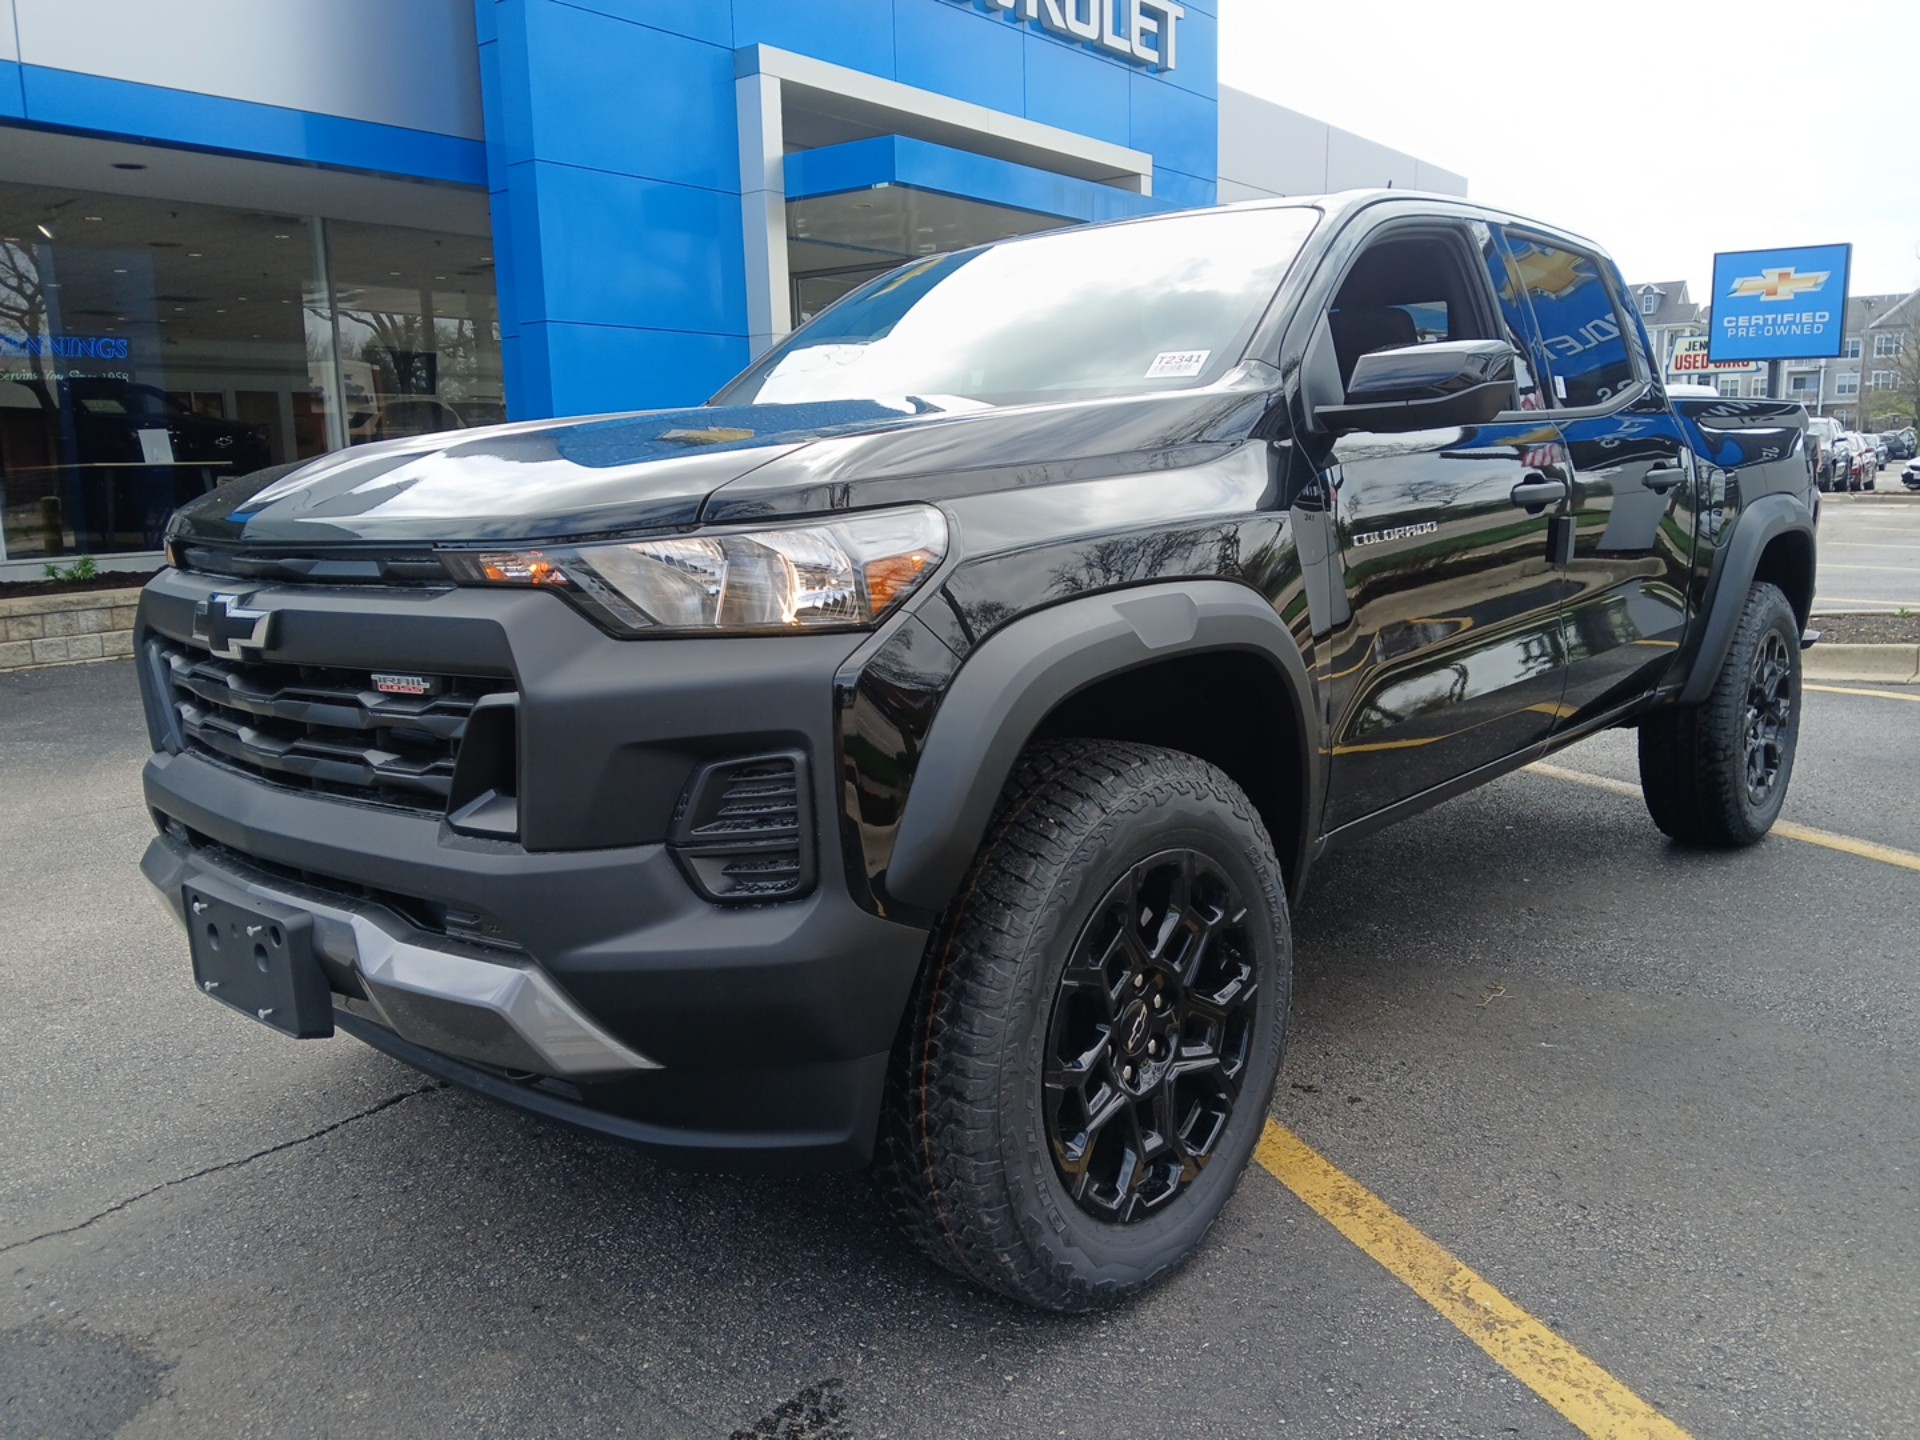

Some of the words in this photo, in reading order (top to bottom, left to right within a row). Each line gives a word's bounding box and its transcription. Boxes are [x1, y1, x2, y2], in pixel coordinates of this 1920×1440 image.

[986, 0, 1185, 71] OLET
[1723, 312, 1830, 328] CERTIFIED
[1727, 324, 1824, 338] PRE-OWNED
[0, 336, 129, 360] NNINGS
[1158, 354, 1202, 365] T2341
[1674, 353, 1710, 370] USED
[1352, 521, 1438, 547] COLORADO
[371, 674, 430, 688] TRAIL
[378, 683, 425, 694] BOSS
